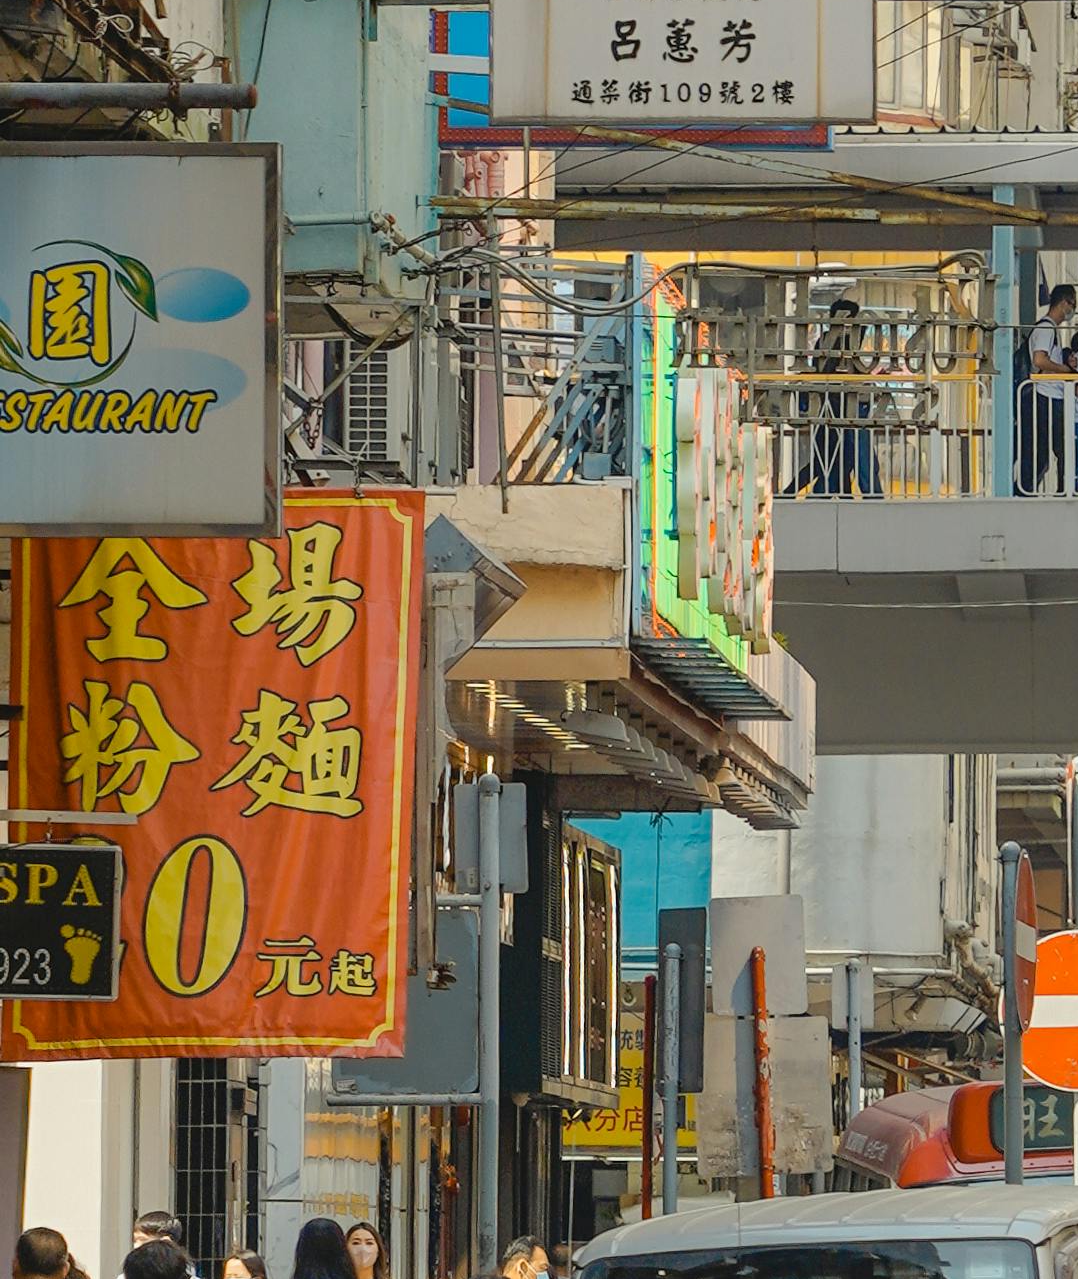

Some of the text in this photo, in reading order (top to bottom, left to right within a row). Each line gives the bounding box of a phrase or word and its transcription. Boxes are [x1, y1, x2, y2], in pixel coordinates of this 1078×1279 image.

[29, 260, 113, 367] 園
[0, 389, 217, 433] STAURANT
[59, 521, 364, 668] 全場
[60, 679, 364, 819] 粉麵
